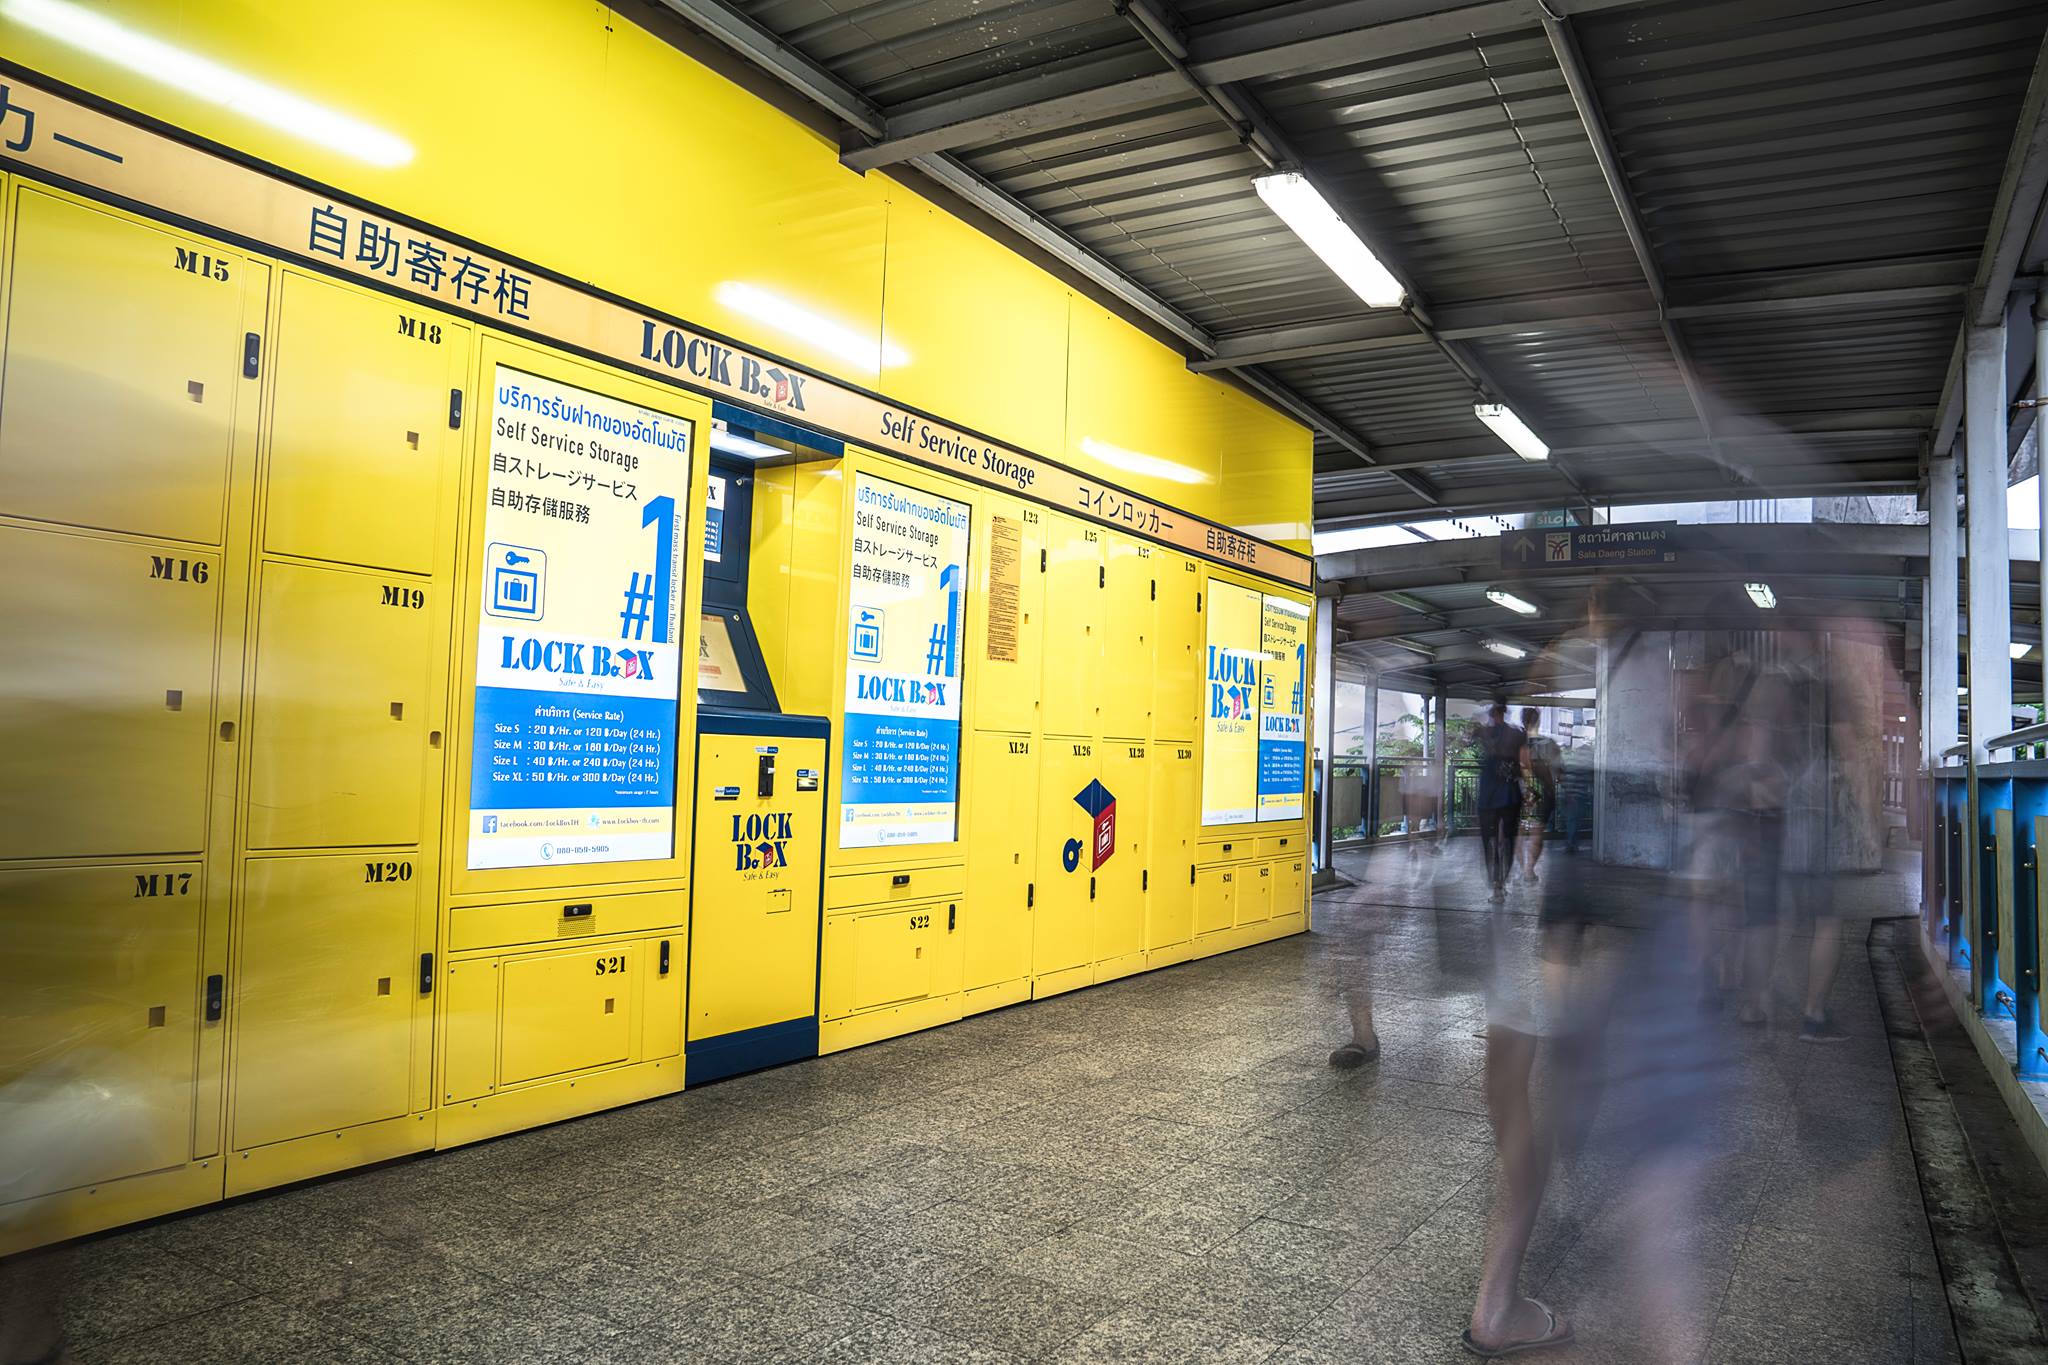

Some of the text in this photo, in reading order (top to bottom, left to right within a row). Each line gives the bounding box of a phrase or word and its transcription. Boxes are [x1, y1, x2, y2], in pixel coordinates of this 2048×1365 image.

[174, 246, 230, 284] M15
[308, 204, 531, 320] 自助寄存柜
[397, 315, 443, 346] M18
[641, 320, 732, 386] LOCK
[499, 385, 686, 452] บริการรับฝากของอัตโนมัติ
[496, 417, 639, 472] Self Service Storage
[880, 411, 1036, 489] Self Service Storage
[493, 452, 638, 501] 自ストレージサービス
[491, 487, 591, 525] 自助存儲服務
[858, 486, 967, 530] บริการรับฝากของอัตโนมัติ
[1024, 510, 1039, 525] L23
[1079, 486, 1174, 534] コインロッカー
[856, 510, 939, 547] Self Service Storage
[1085, 530, 1098, 543] L25
[1578, 528, 1666, 544] สถานีศาลาแดง
[854, 537, 938, 569] 自ストレージサービス
[1205, 527, 1257, 564] 自助寄存柜
[1578, 549, 1596, 559] Sala
[1598, 549, 1625, 560] Daeng
[1627, 547, 1656, 557] Station
[149, 556, 209, 584] M16
[620, 495, 675, 643] #1
[381, 585, 425, 610] M19
[501, 636, 584, 675] LOCK
[1208, 645, 1256, 686] LOCK
[857, 675, 905, 702] LOCK
[573, 707, 602, 721] (Service
[604, 708, 624, 723] Rate)
[1265, 716, 1284, 733] LOCK
[494, 723, 512, 733] Size
[514, 723, 520, 733] S
[534, 725, 546, 734] 20
[573, 728, 582, 736] or
[585, 727, 602, 737] 120
[629, 727, 644, 740] (24
[646, 729, 661, 741] Hr.)
[493, 739, 511, 749] Size
[513, 739, 522, 749] M
[533, 741, 546, 750] 30
[629, 742, 644, 755] (24
[645, 743, 660, 756] Hr.)
[1009, 742, 1029, 754] XL24
[1073, 745, 1091, 756] XL26
[1129, 748, 1145, 758] XL28
[1177, 749, 1192, 760] XL30
[493, 755, 511, 766] Size
[513, 756, 518, 765] L
[533, 756, 545, 766] 40
[583, 757, 600, 767] 240
[628, 757, 643, 770] (24
[645, 757, 660, 770] Hr.)
[492, 771, 510, 782] Size
[512, 772, 523, 782] XL
[532, 772, 544, 782] 50
[582, 772, 600, 782] 300
[627, 772, 642, 784] (24
[644, 772, 659, 784] Hr.)
[732, 813, 793, 841] LOCK
[133, 873, 193, 898] M17
[364, 862, 413, 884] M20
[743, 870, 757, 881] Safe
[765, 869, 779, 879] Easy
[910, 915, 930, 931] S22
[595, 955, 627, 976] S21
